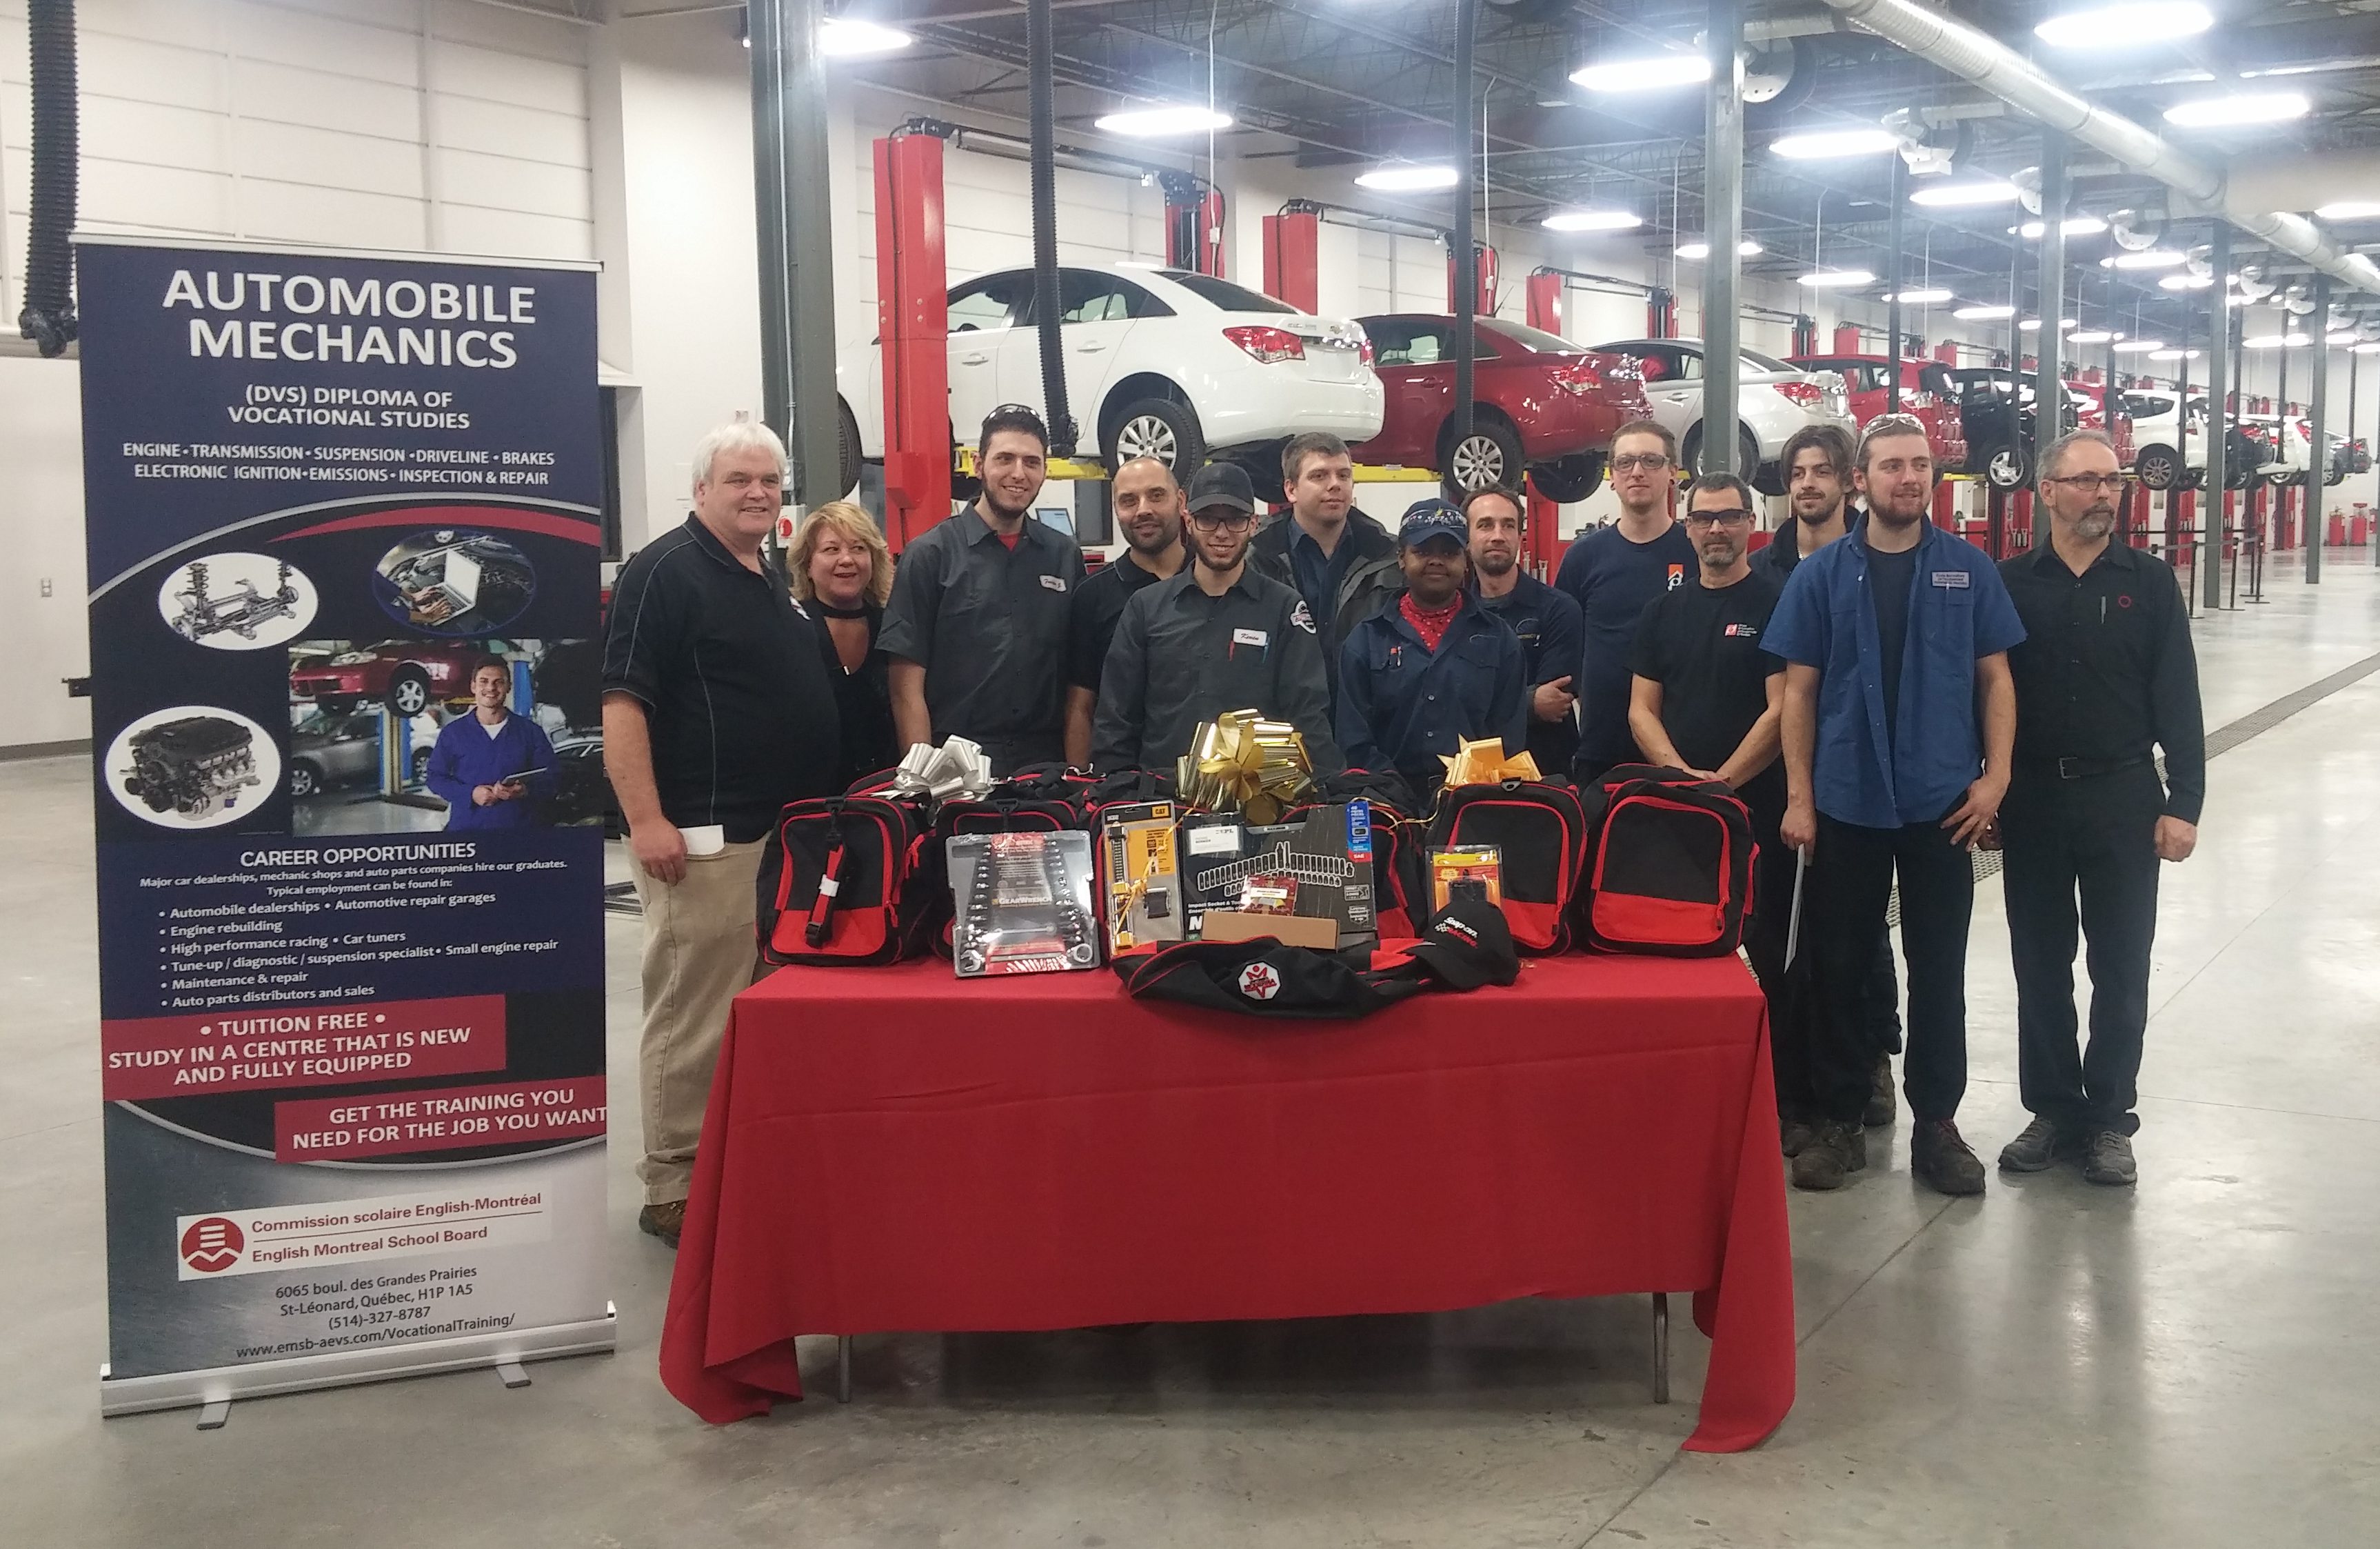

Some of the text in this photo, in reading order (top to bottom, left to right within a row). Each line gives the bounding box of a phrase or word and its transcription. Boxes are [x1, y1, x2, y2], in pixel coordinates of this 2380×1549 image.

[162, 269, 536, 324] AUTOMOBILE
[190, 319, 518, 369] MECHANICS
[245, 384, 452, 408] (DVS) DIPLOMA OF
[228, 406, 470, 429] VOCATIONAL STUDIES
[123, 443, 555, 466] ENGINE TRANSMISSION SUSPENSION DRIVELINE BRAKES
[134, 463, 549, 484] ELECTRONIC IGNITION EMISSIONS INSPECTION & REPAIR
[241, 843, 476, 867] CAREER OPPORTUNITIES
[140, 877, 172, 888] Major
[194, 873, 259, 886] dealerships,
[260, 871, 310, 881] mechanic
[312, 870, 342, 881] shops
[345, 868, 363, 877] and
[365, 868, 389, 877] auto
[391, 866, 418, 878] parts
[420, 863, 473, 876] companies
[475, 863, 495, 871] hire
[516, 860, 567, 872] graduates.
[267, 879, 452, 897] Typical employment can be found in:
[170, 893, 496, 919] Automobile dealerships Automotive repair garages
[171, 921, 283, 939] Engine rebuilding
[171, 933, 406, 957] High performance racing Car tuners
[172, 939, 558, 972] Tune-up / diagnostic / suspension specialist Small engine repair
[172, 971, 309, 990] Maintenance & repair
[172, 984, 375, 1008] Auto parts distributors and sales
[217, 1012, 368, 1037] TUITION FREE
[108, 1027, 472, 1069] STUDY IN A CENTRE THAT IS NEW
[173, 1053, 412, 1086] AND FULLY EQUIPPED
[329, 1088, 574, 1124] GET THE TRAINING YOU
[293, 1106, 606, 1150] NEED FOR THE JOB YOU WANT
[252, 1192, 541, 1233] Commission scolaire English-Montréal
[252, 1226, 487, 1263] English Montreal School Board
[275, 1266, 477, 1299] 6065 boul. des Grandes Prairies
[280, 1283, 474, 1317] St-Léonard, Québec, H1P 1A5
[328, 1306, 432, 1330] (514)-327-8787
[236, 1312, 516, 1359] www.emsb-aevs.com/VocationalTraining/
